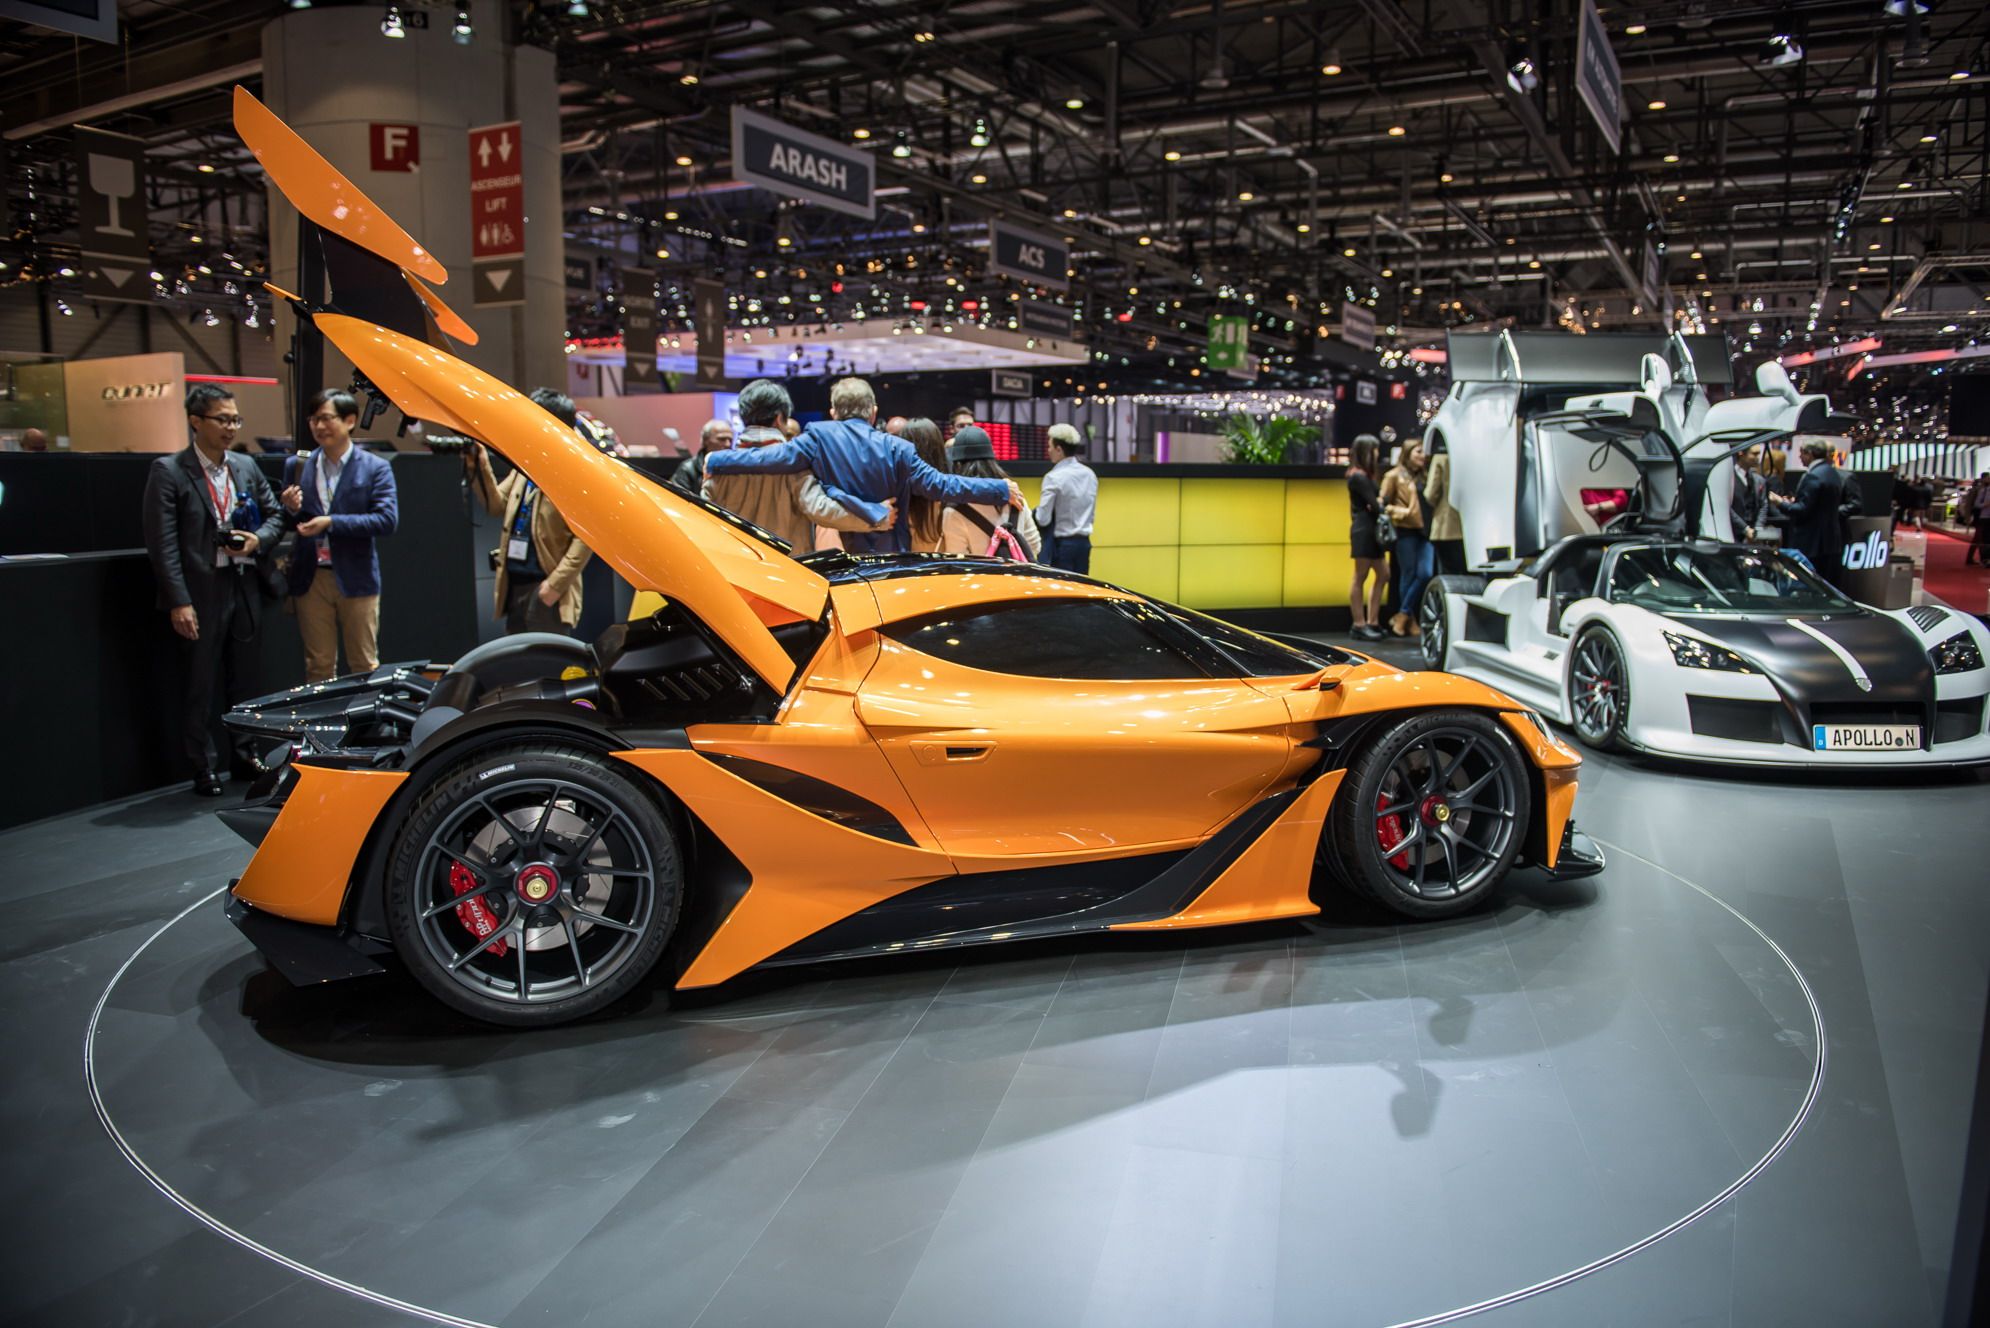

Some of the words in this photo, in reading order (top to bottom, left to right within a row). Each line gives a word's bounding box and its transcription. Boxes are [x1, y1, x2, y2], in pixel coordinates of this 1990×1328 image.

[383, 126, 409, 161] F
[470, 174, 522, 191] ASCENSEUR
[769, 143, 847, 192] ARASH
[485, 197, 508, 212] LIFT
[1018, 243, 1045, 269] ACS
[1842, 530, 1888, 570] ollo
[1833, 729, 1892, 746] APOLLO
[1905, 729, 1915, 746] N
[394, 790, 448, 881] MICHELIN
